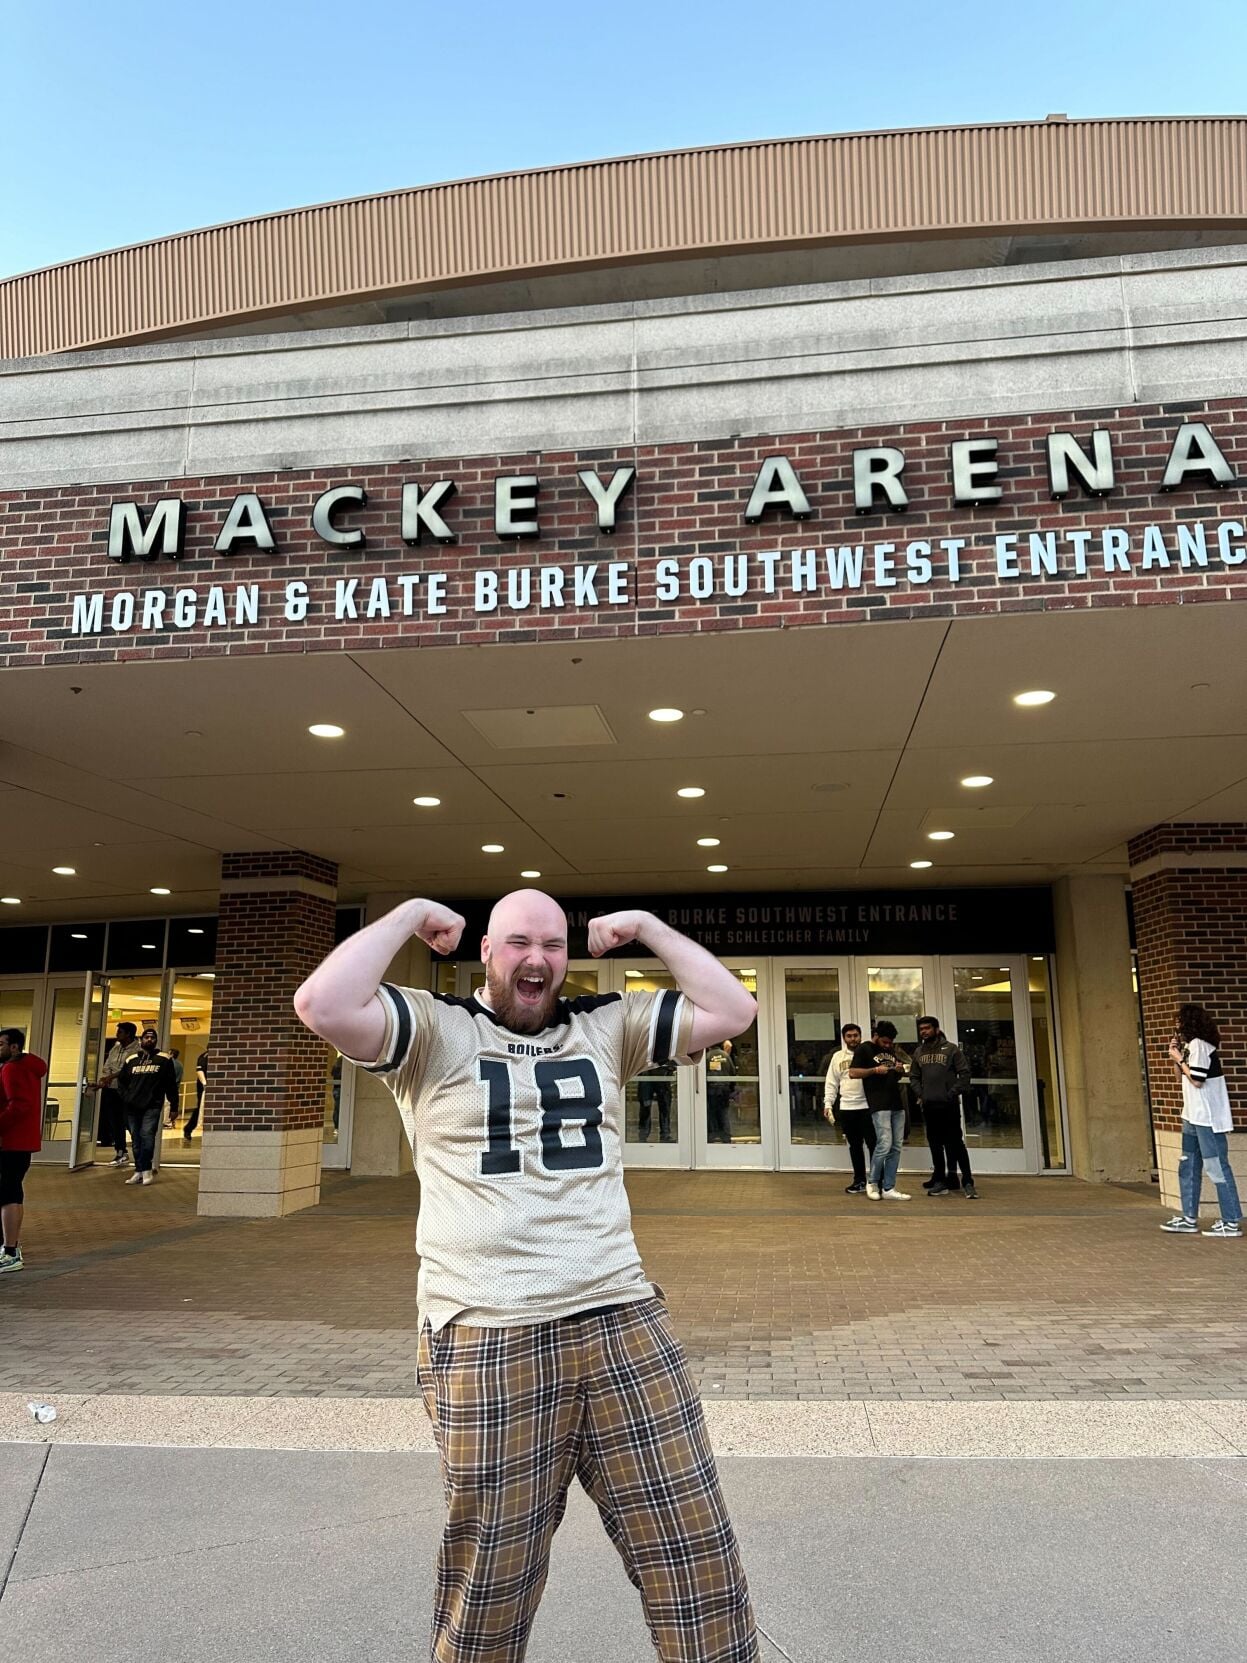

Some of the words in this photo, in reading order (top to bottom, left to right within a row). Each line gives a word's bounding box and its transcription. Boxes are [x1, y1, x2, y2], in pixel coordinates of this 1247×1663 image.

[107, 466, 636, 563] MACKEY
[744, 421, 1236, 525] ARENA
[71, 584, 260, 635] MORGAN
[284, 580, 309, 622] &
[334, 571, 448, 620] KATE
[473, 562, 630, 613] BURKE
[656, 538, 966, 601] SOUTHWEST
[668, 908, 727, 926] BURKE
[736, 905, 849, 925] SOUTHWEST
[858, 904, 959, 922] ENTRANCE
[698, 930, 721, 944] THE
[727, 929, 812, 944] SCHLEICHER
[818, 928, 870, 943] FAMILY
[476, 1056, 606, 1178] 18
